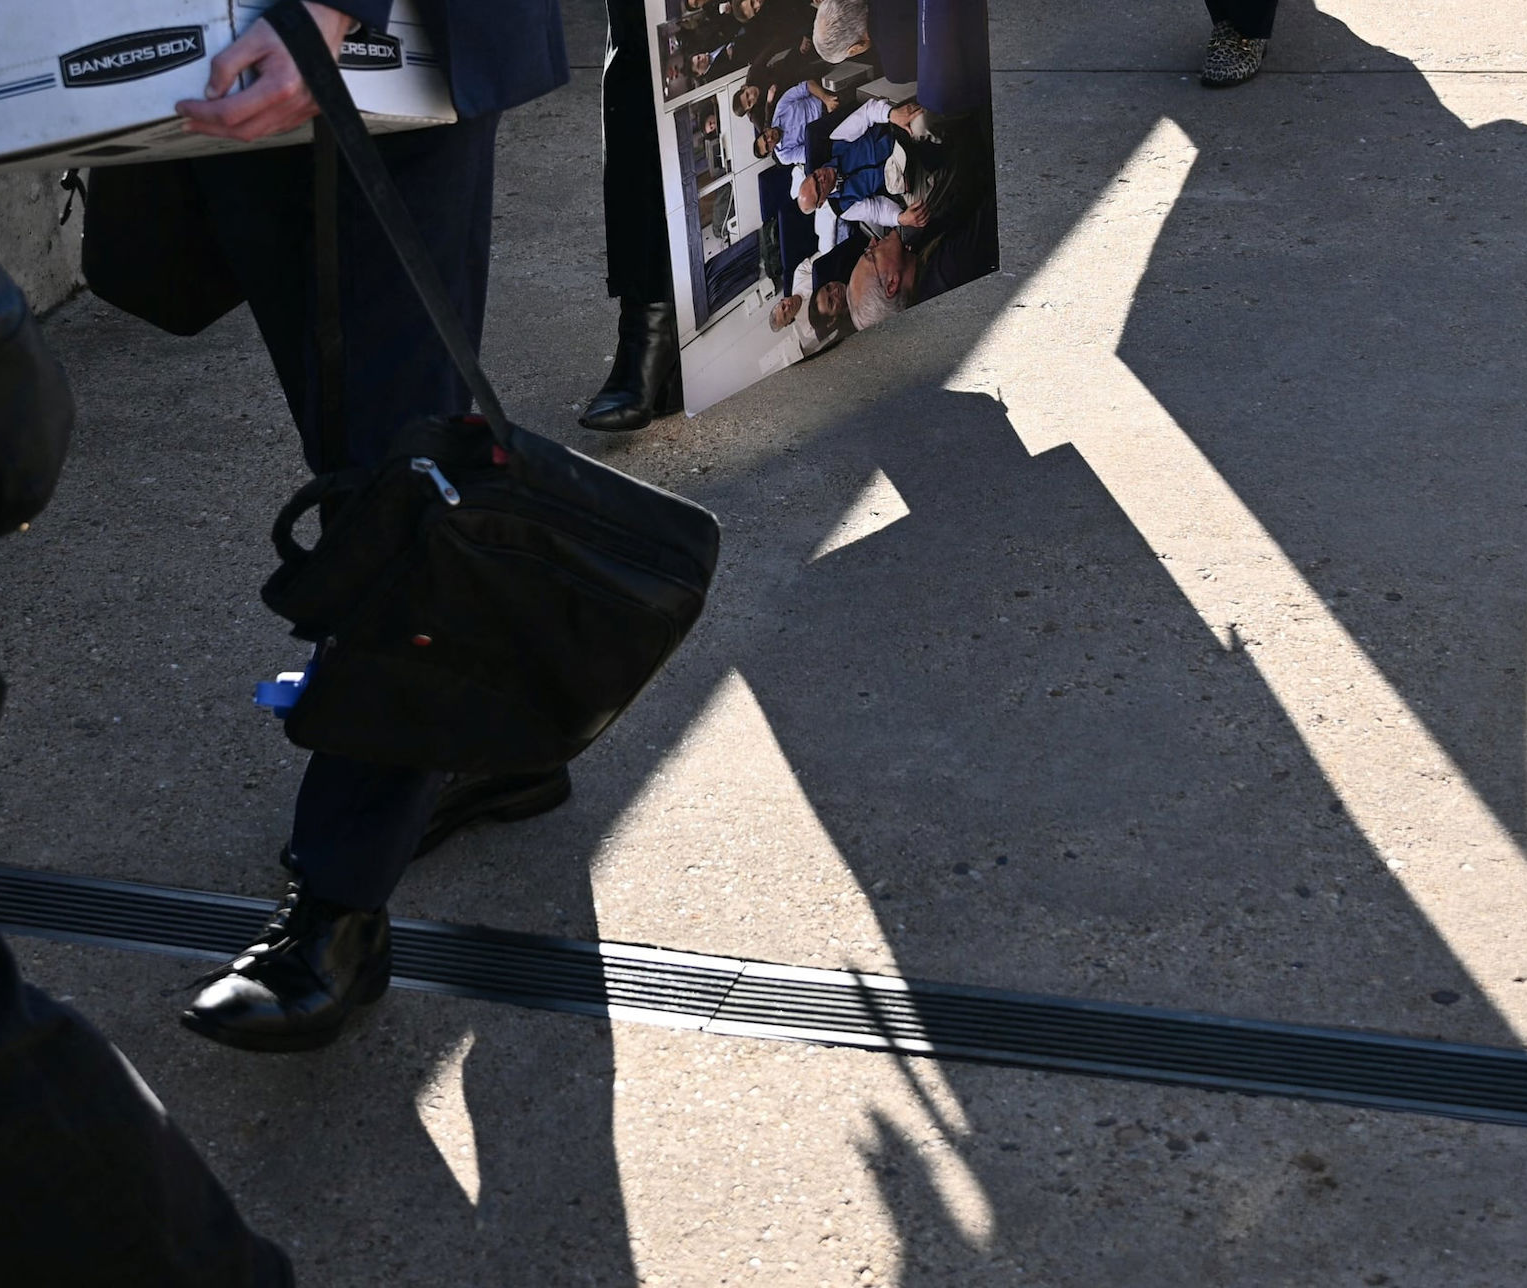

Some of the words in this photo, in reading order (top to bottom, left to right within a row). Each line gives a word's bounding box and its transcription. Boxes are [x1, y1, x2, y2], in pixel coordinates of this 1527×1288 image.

[68, 45, 155, 78] BANKERS
[157, 36, 197, 57] BOX
[368, 43, 396, 59] BOX
